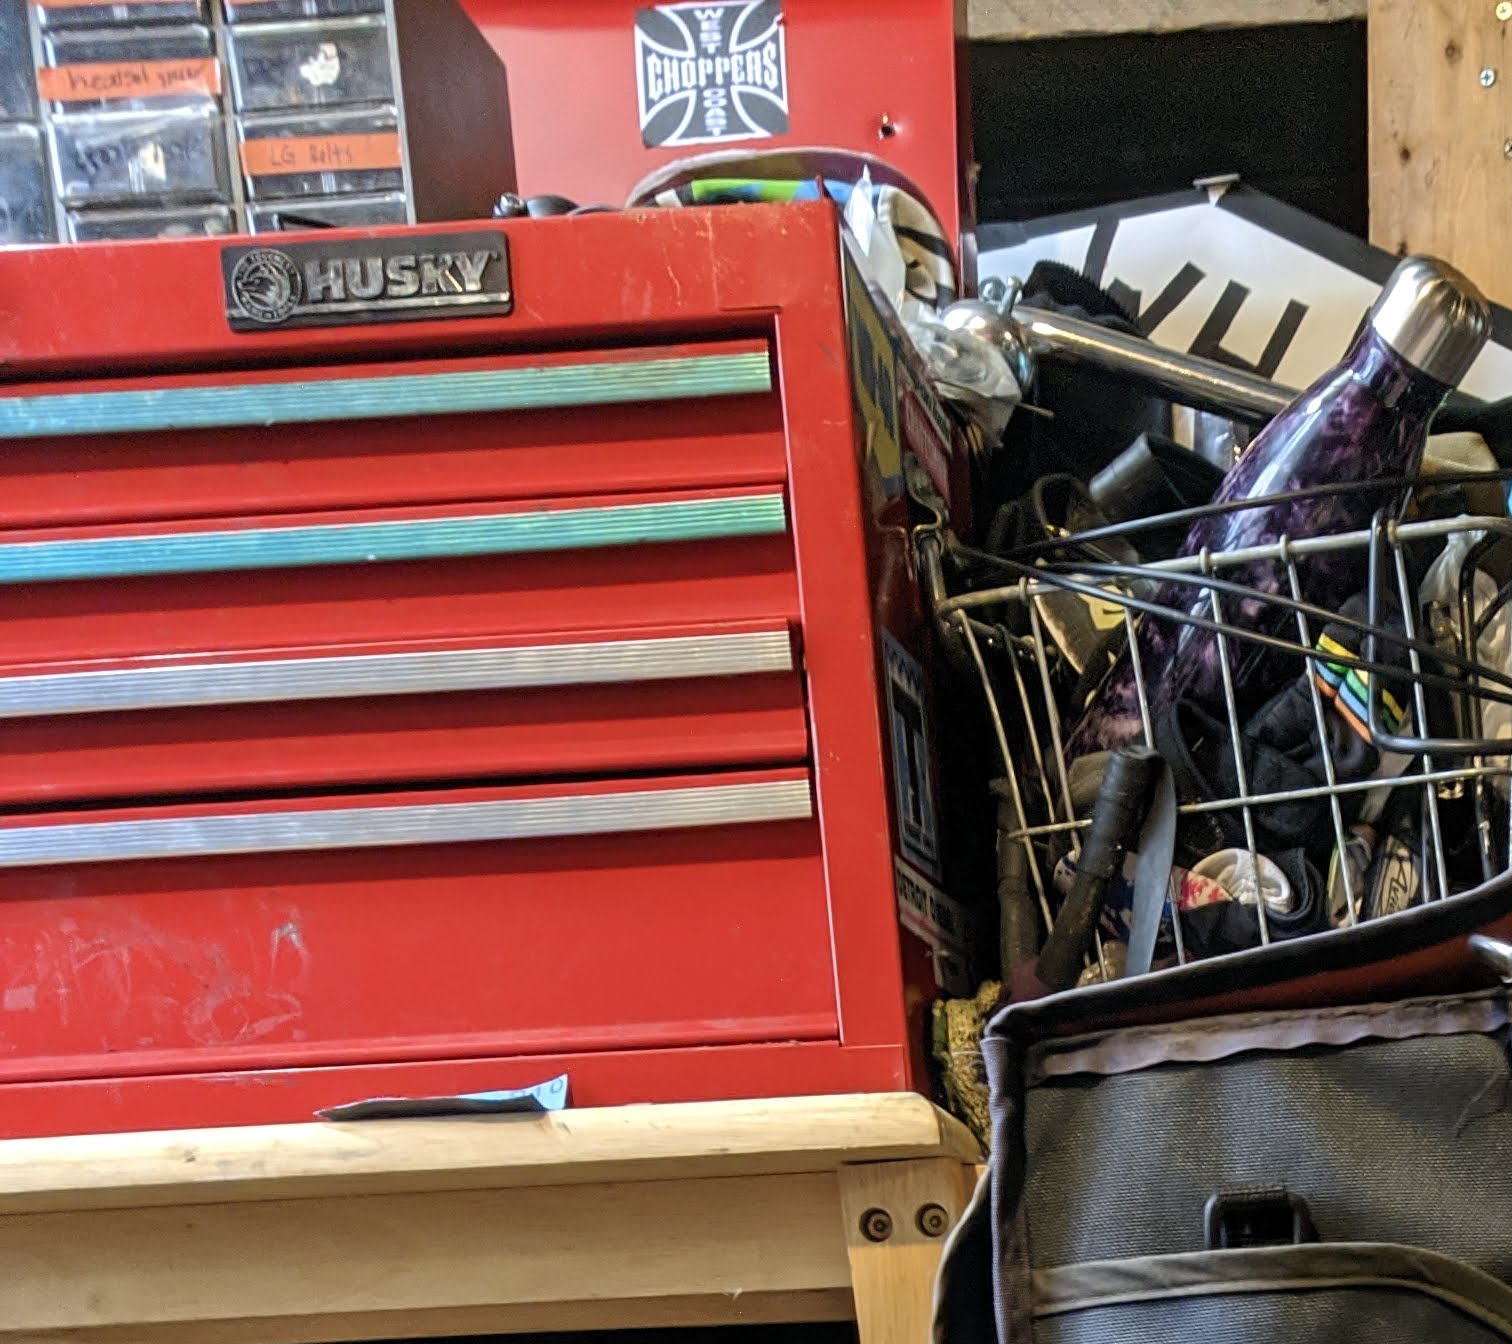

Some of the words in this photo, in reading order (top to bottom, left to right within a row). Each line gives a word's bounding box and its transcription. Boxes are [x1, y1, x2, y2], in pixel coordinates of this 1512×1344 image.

[693, 8, 725, 54] WEST
[646, 40, 779, 102] CHOPPERS
[703, 88, 728, 137] COAST
[309, 142, 353, 164] Bolts
[304, 250, 491, 301] HUSKY
